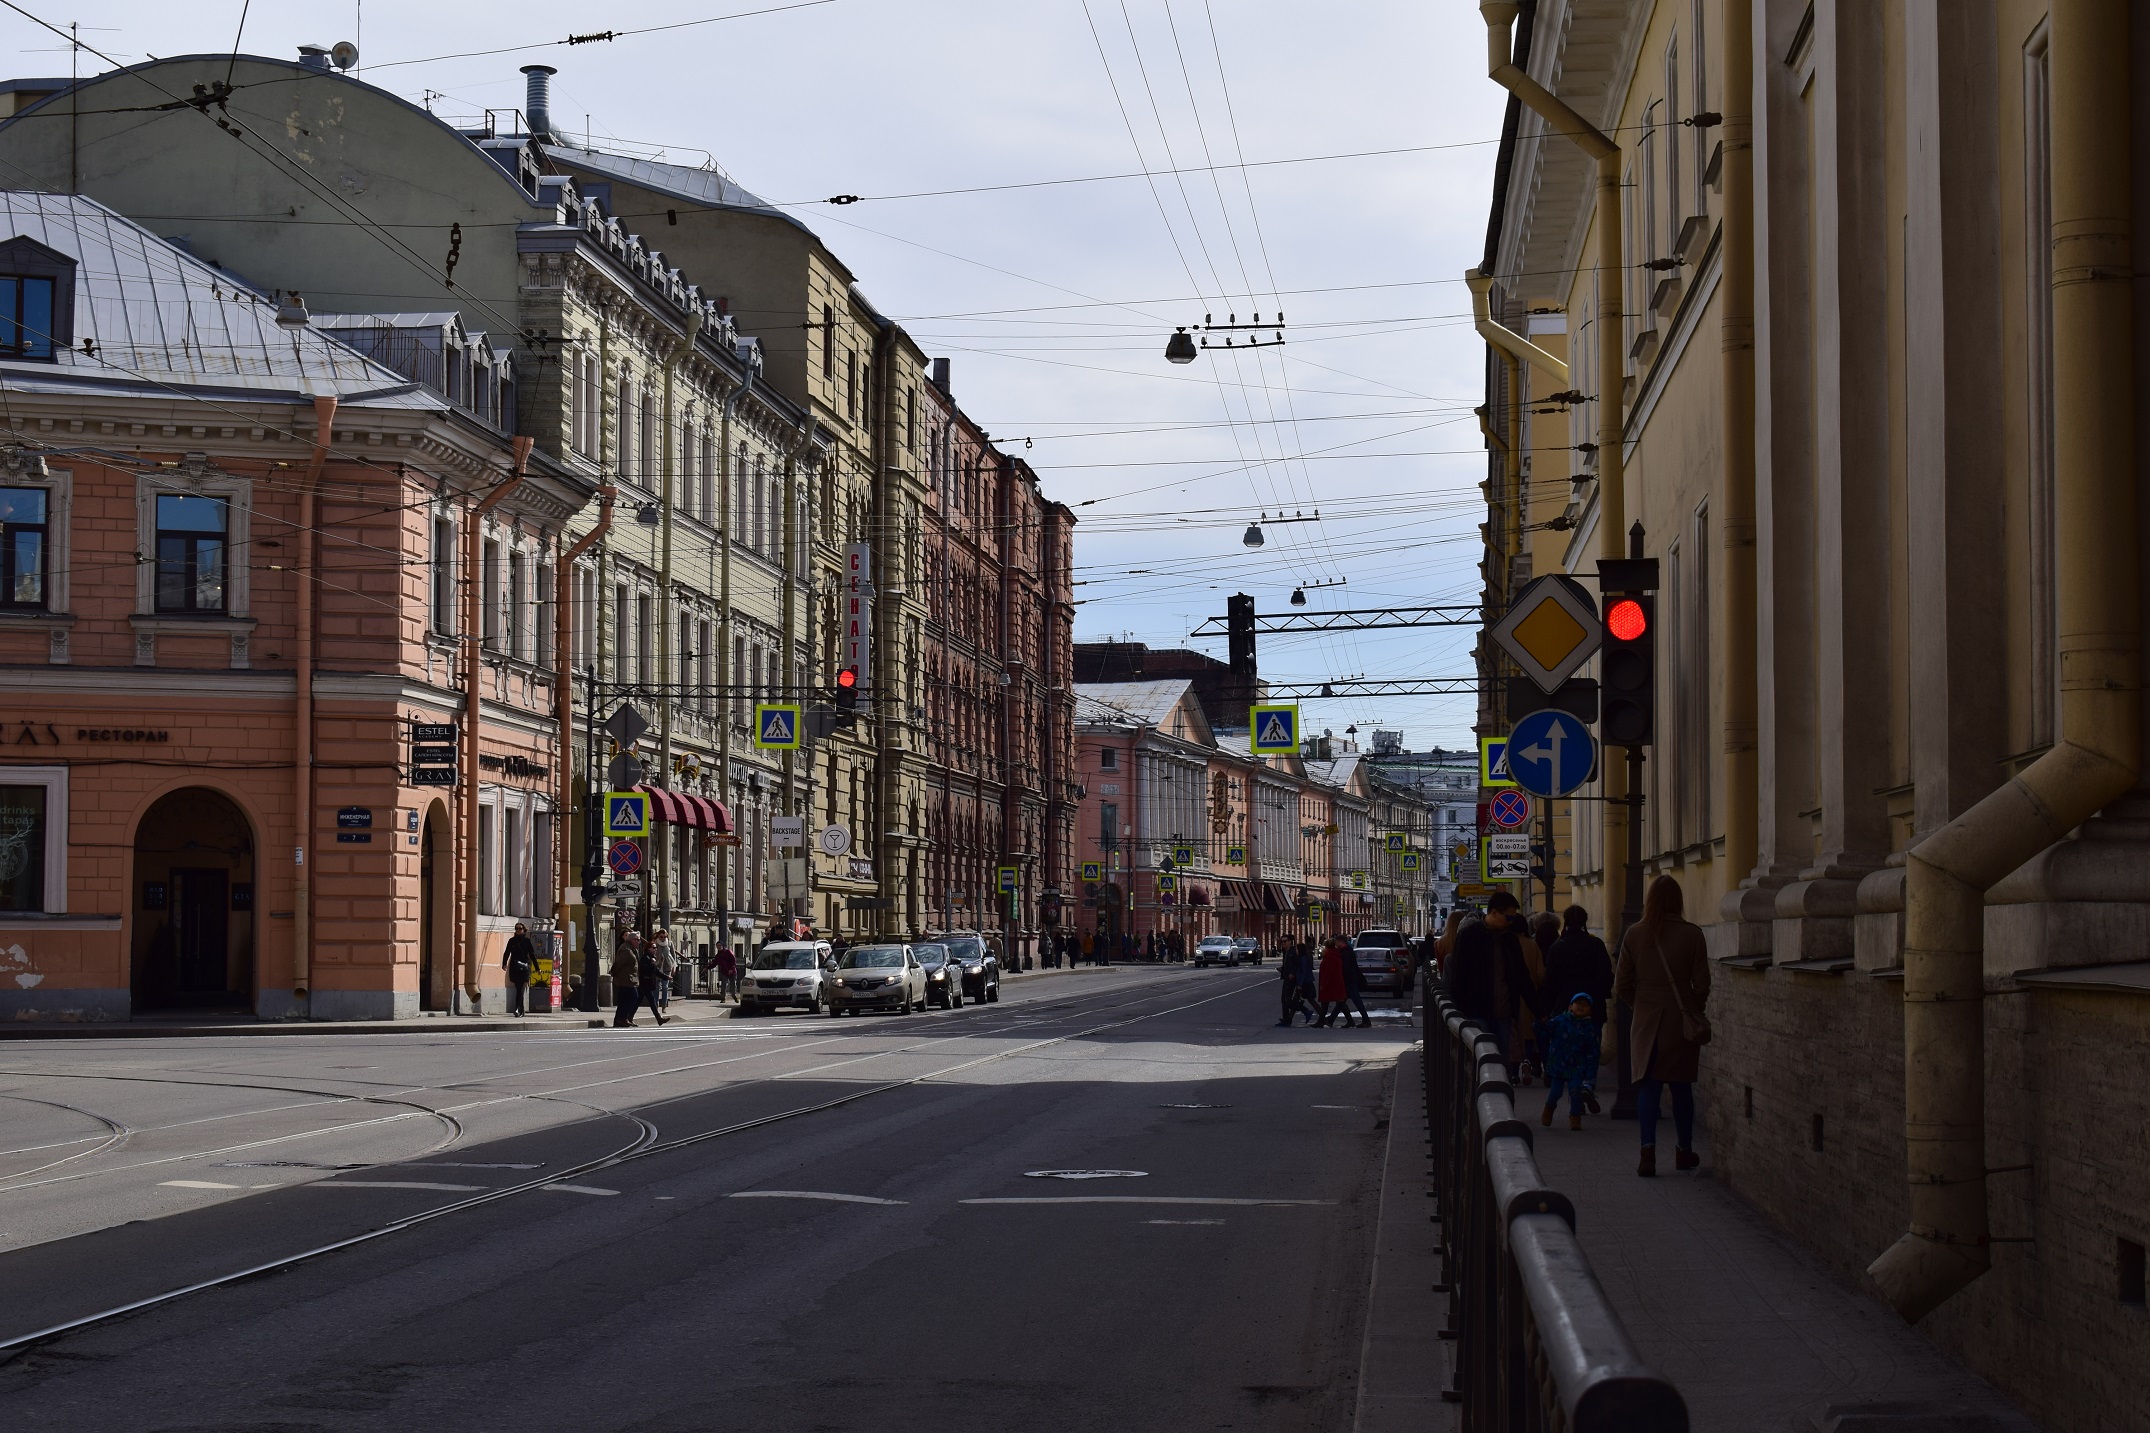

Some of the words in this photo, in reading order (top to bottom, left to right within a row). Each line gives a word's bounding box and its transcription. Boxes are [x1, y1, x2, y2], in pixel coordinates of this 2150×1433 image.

[77, 729, 168, 742] РЕСТОРАН
[418, 727, 450, 735] ESTEL
[415, 770, 452, 780] GRÄS
[0, 805, 35, 815] drinks
[2, 815, 35, 826] tapas
[772, 827, 801, 835] BACKSTAGE
